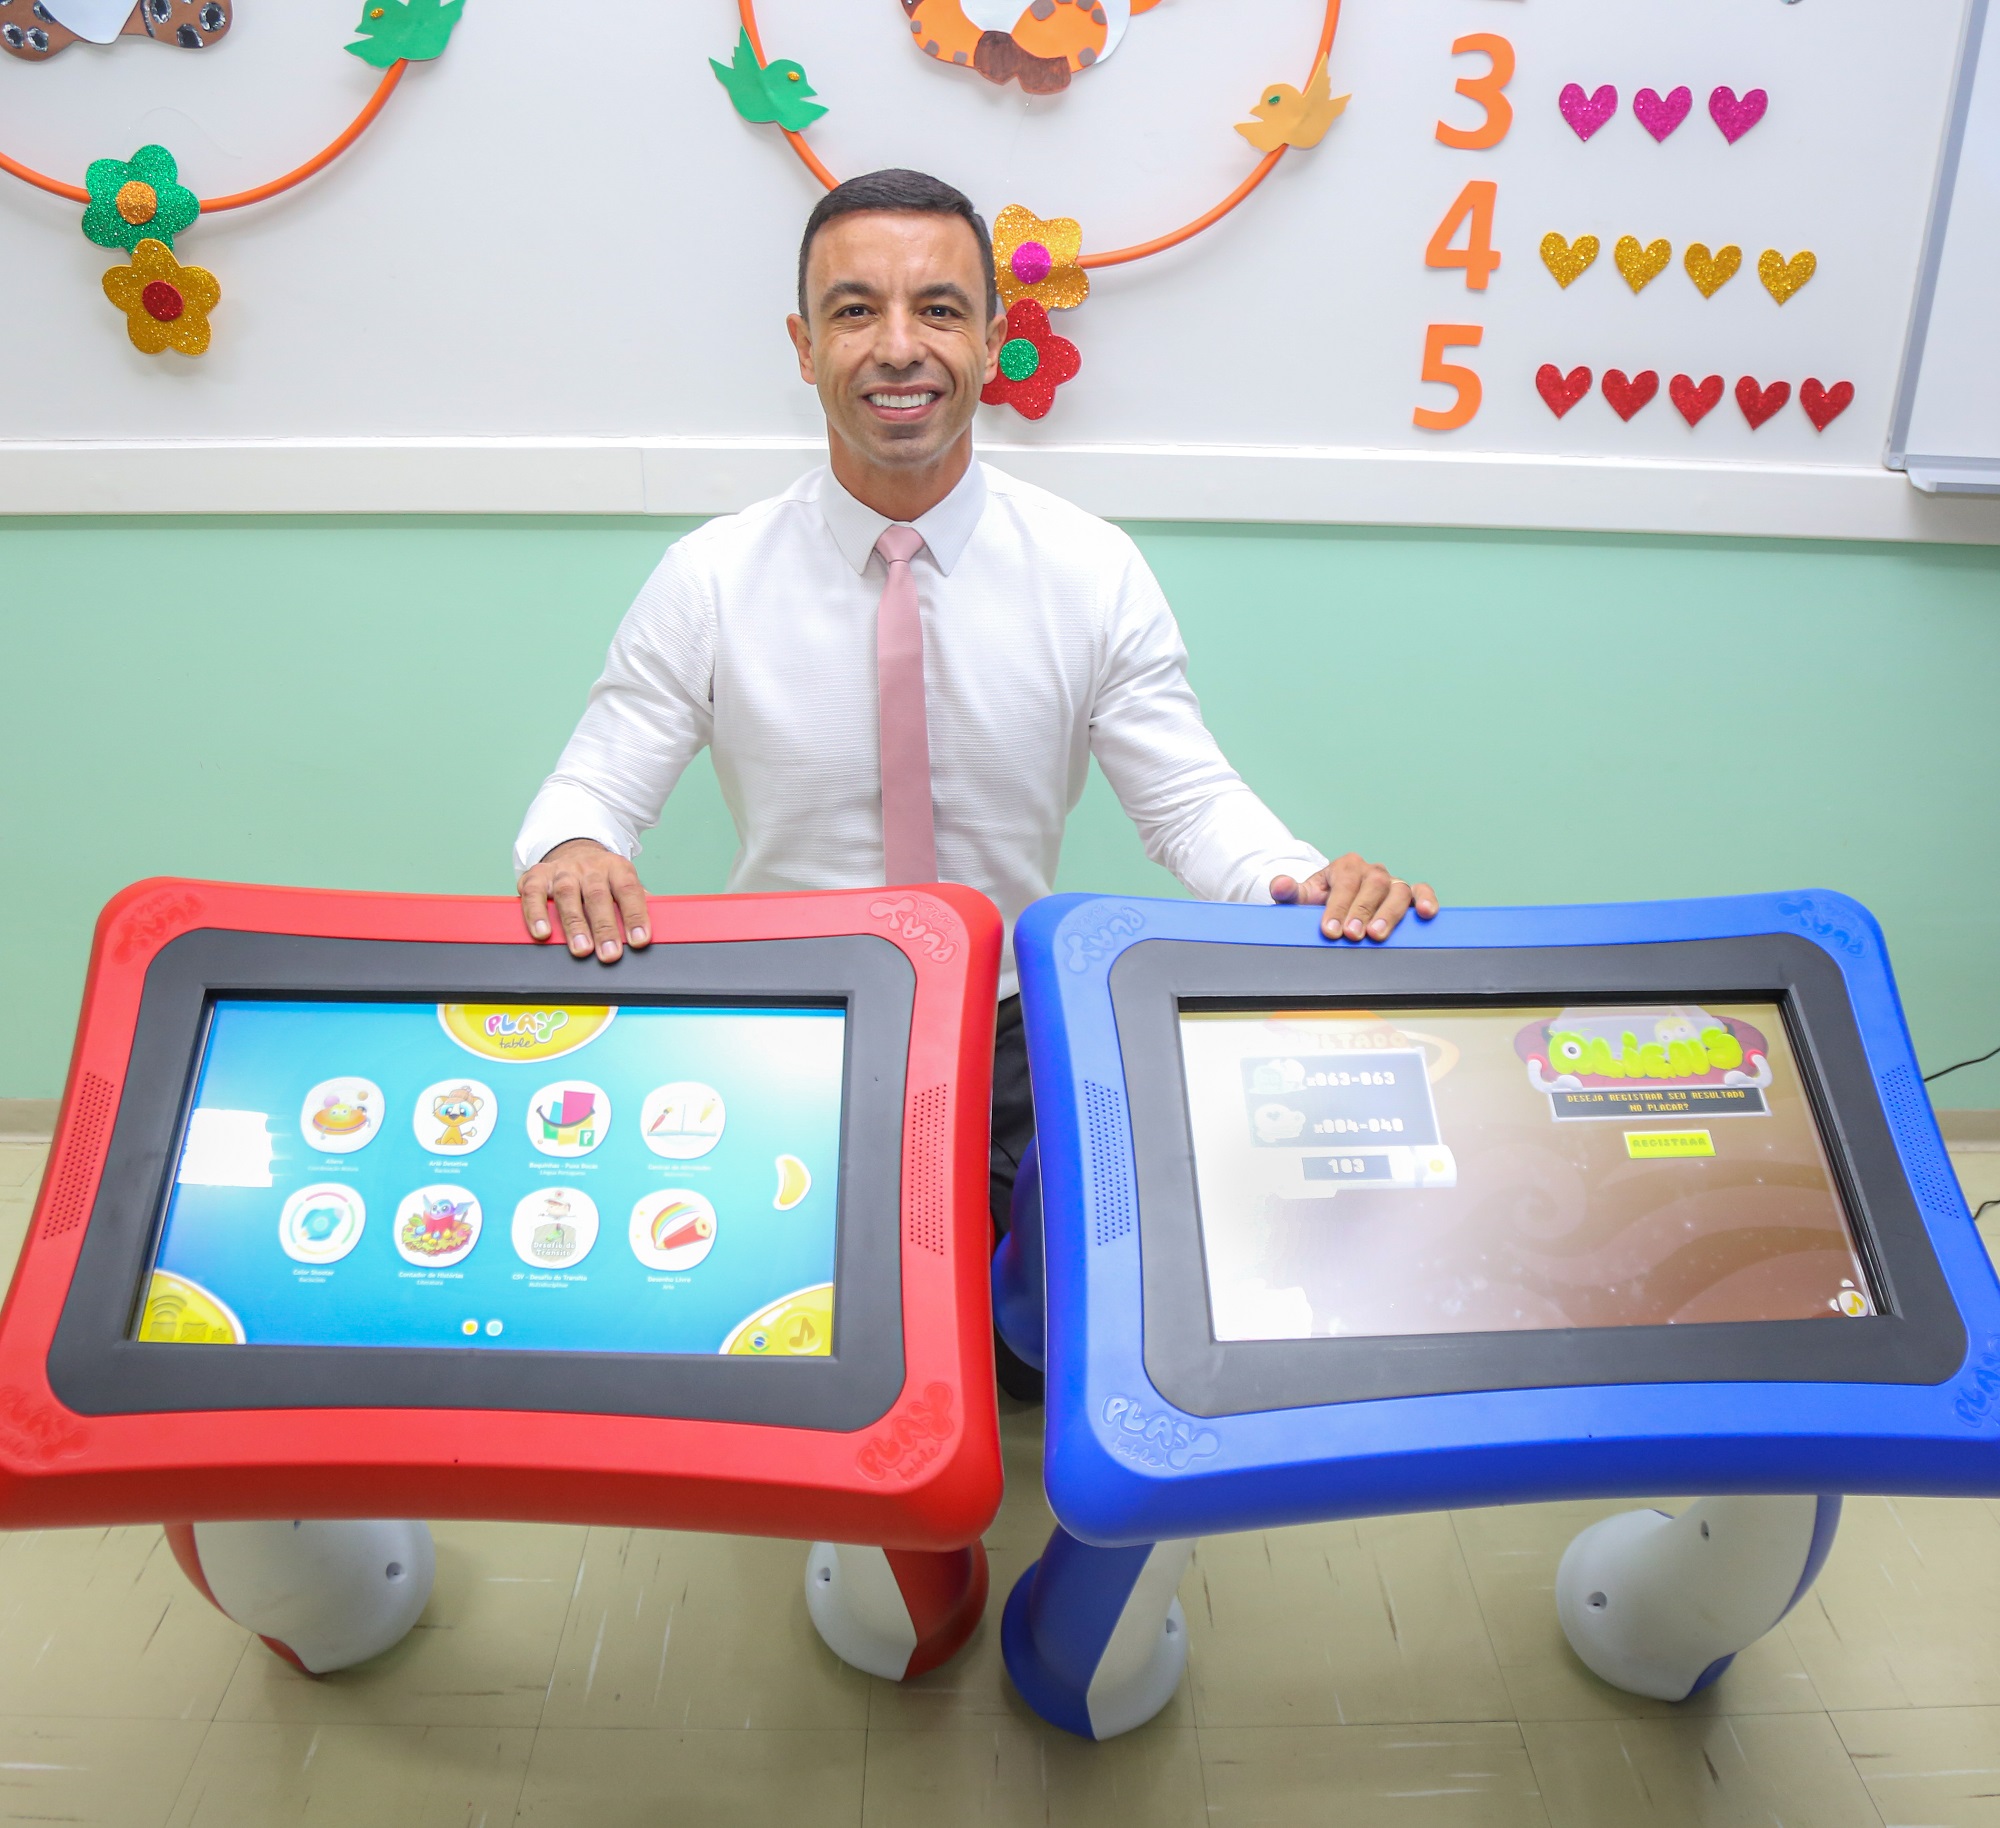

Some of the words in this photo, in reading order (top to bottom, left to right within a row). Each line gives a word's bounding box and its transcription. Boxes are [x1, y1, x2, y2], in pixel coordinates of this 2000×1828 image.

[1435, 33, 1516, 150] 3
[1425, 180, 1501, 290] 4
[1413, 324, 1484, 430] 5
[869, 894, 960, 965] PLAY
[1063, 906, 1145, 974] PLAY
[485, 1010, 569, 1043] PLAY
[499, 1037, 535, 1049] table
[1566, 1094, 1604, 1103] DESEJA
[1609, 1091, 1663, 1102] REGISTRAR
[1668, 1091, 1687, 1100] SEU
[1691, 1089, 1745, 1100] RESULTADO
[1629, 1103, 1643, 1112] NO
[1647, 1103, 1689, 1112] PLACAR?
[583, 1131, 592, 1145] P
[1633, 1137, 1707, 1148] REGISTRAR
[1328, 1158, 1365, 1173] 103
[533, 1241, 563, 1249] Desafio
[857, 1383, 955, 1482] PLAY
[1101, 1394, 1221, 1472] PLAY
